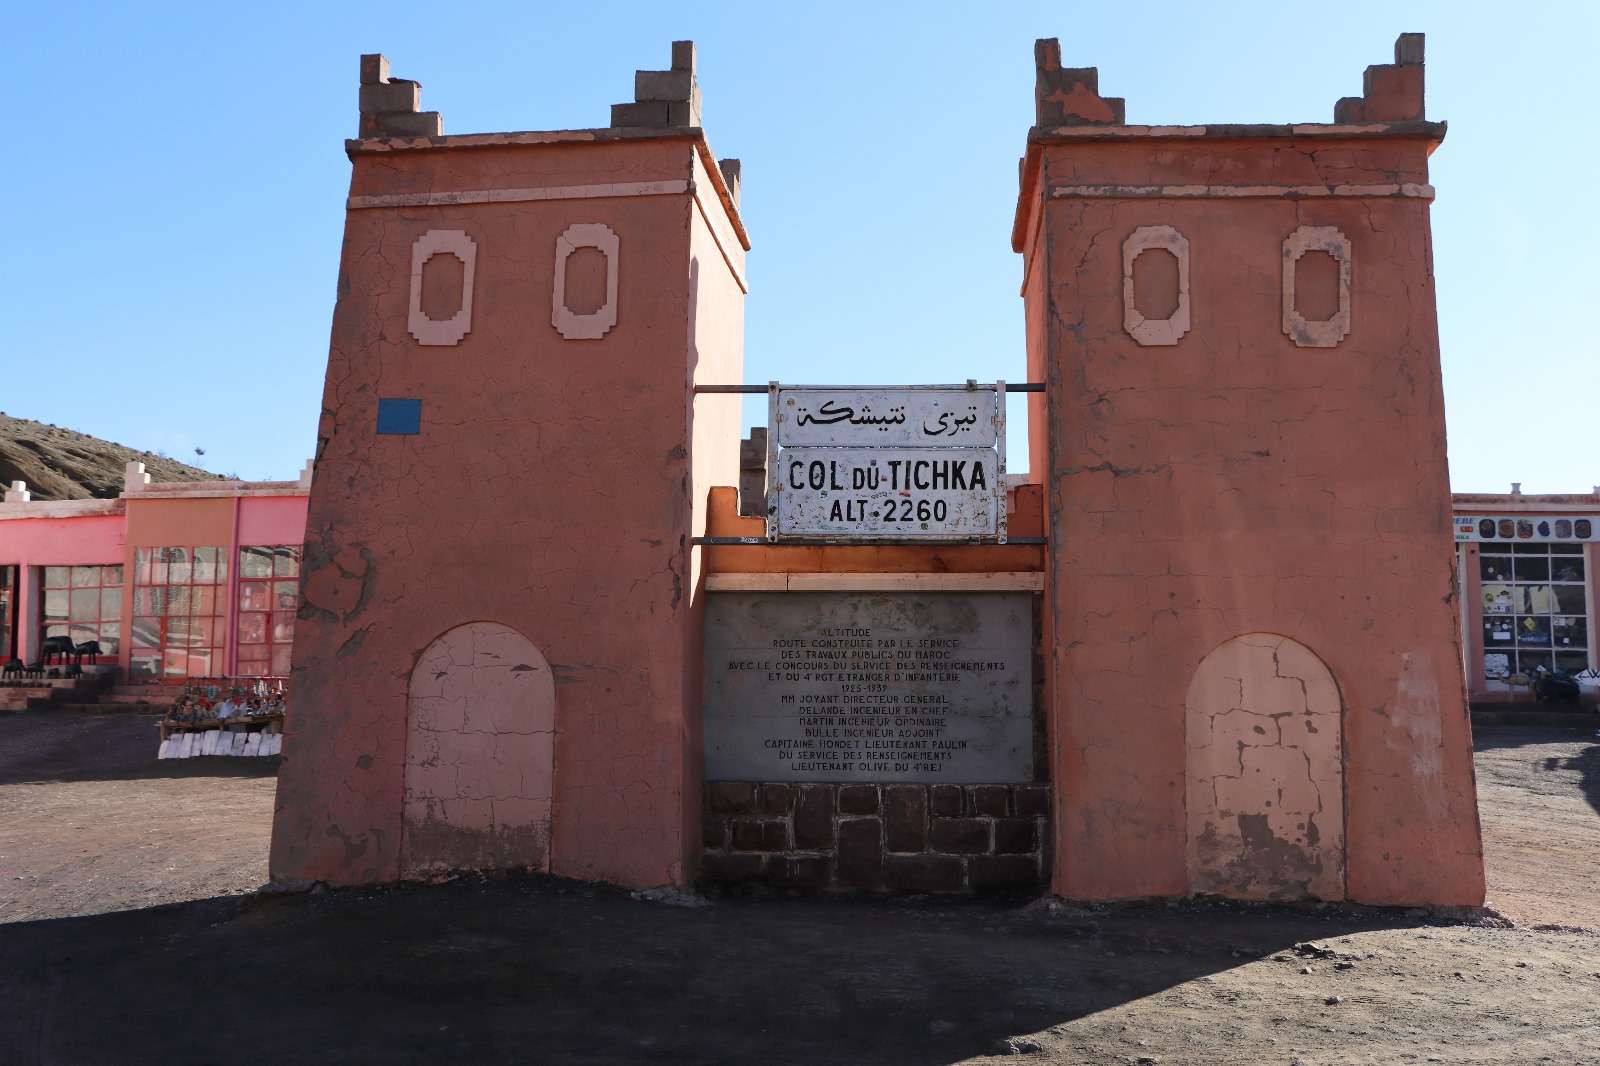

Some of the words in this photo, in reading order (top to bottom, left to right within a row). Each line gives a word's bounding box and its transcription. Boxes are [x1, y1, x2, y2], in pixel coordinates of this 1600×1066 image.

[789, 460, 844, 490] COL
[853, 468, 879, 490] DU
[888, 460, 986, 491] TICHKA
[883, 499, 947, 522] 2260
[773, 640, 807, 648] ROUTE
[811, 640, 872, 648] CONSTRUITE
[878, 640, 896, 648] PAR
[918, 640, 959, 648] SERVICE
[781, 651, 801, 659] DES
[805, 651, 847, 659] TRAVAUX
[852, 651, 892, 659] PUBLICS
[915, 651, 950, 659] MAROC
[728, 662, 754, 670] AVEC
[775, 662, 828, 670] CONCOURS
[851, 662, 890, 670] SERVICE
[896, 662, 917, 670] DES
[920, 662, 1005, 670] RENSEIGNEMENTS
[815, 673, 833, 681] RGT
[838, 673, 890, 681] ETRANGER
[799, 695, 839, 704] JOYANT
[843, 695, 899, 704] DIRECTEUR
[903, 695, 948, 704] GENERAL
[800, 707, 846, 715] DELANDE
[850, 707, 901, 715] INGENIEUR
[921, 707, 949, 715] CHEF
[800, 718, 834, 726] MARTIN
[838, 718, 891, 726] INGENIEUR
[895, 718, 946, 726] ORDINAIRE
[844, 728, 894, 737] INGENIEUR
[898, 728, 940, 737] ADJOINT
[764, 740, 815, 748] CAPITAINE
[865, 740, 928, 748] LIEUTENANT
[932, 740, 967, 748] PAULIN
[797, 751, 838, 760] SERVICE
[843, 751, 862, 760] DES
[866, 751, 952, 760] RENSEIGNEMENTS
[791, 763, 854, 772] LIEUTENANT
[859, 763, 889, 772] OLIVE
